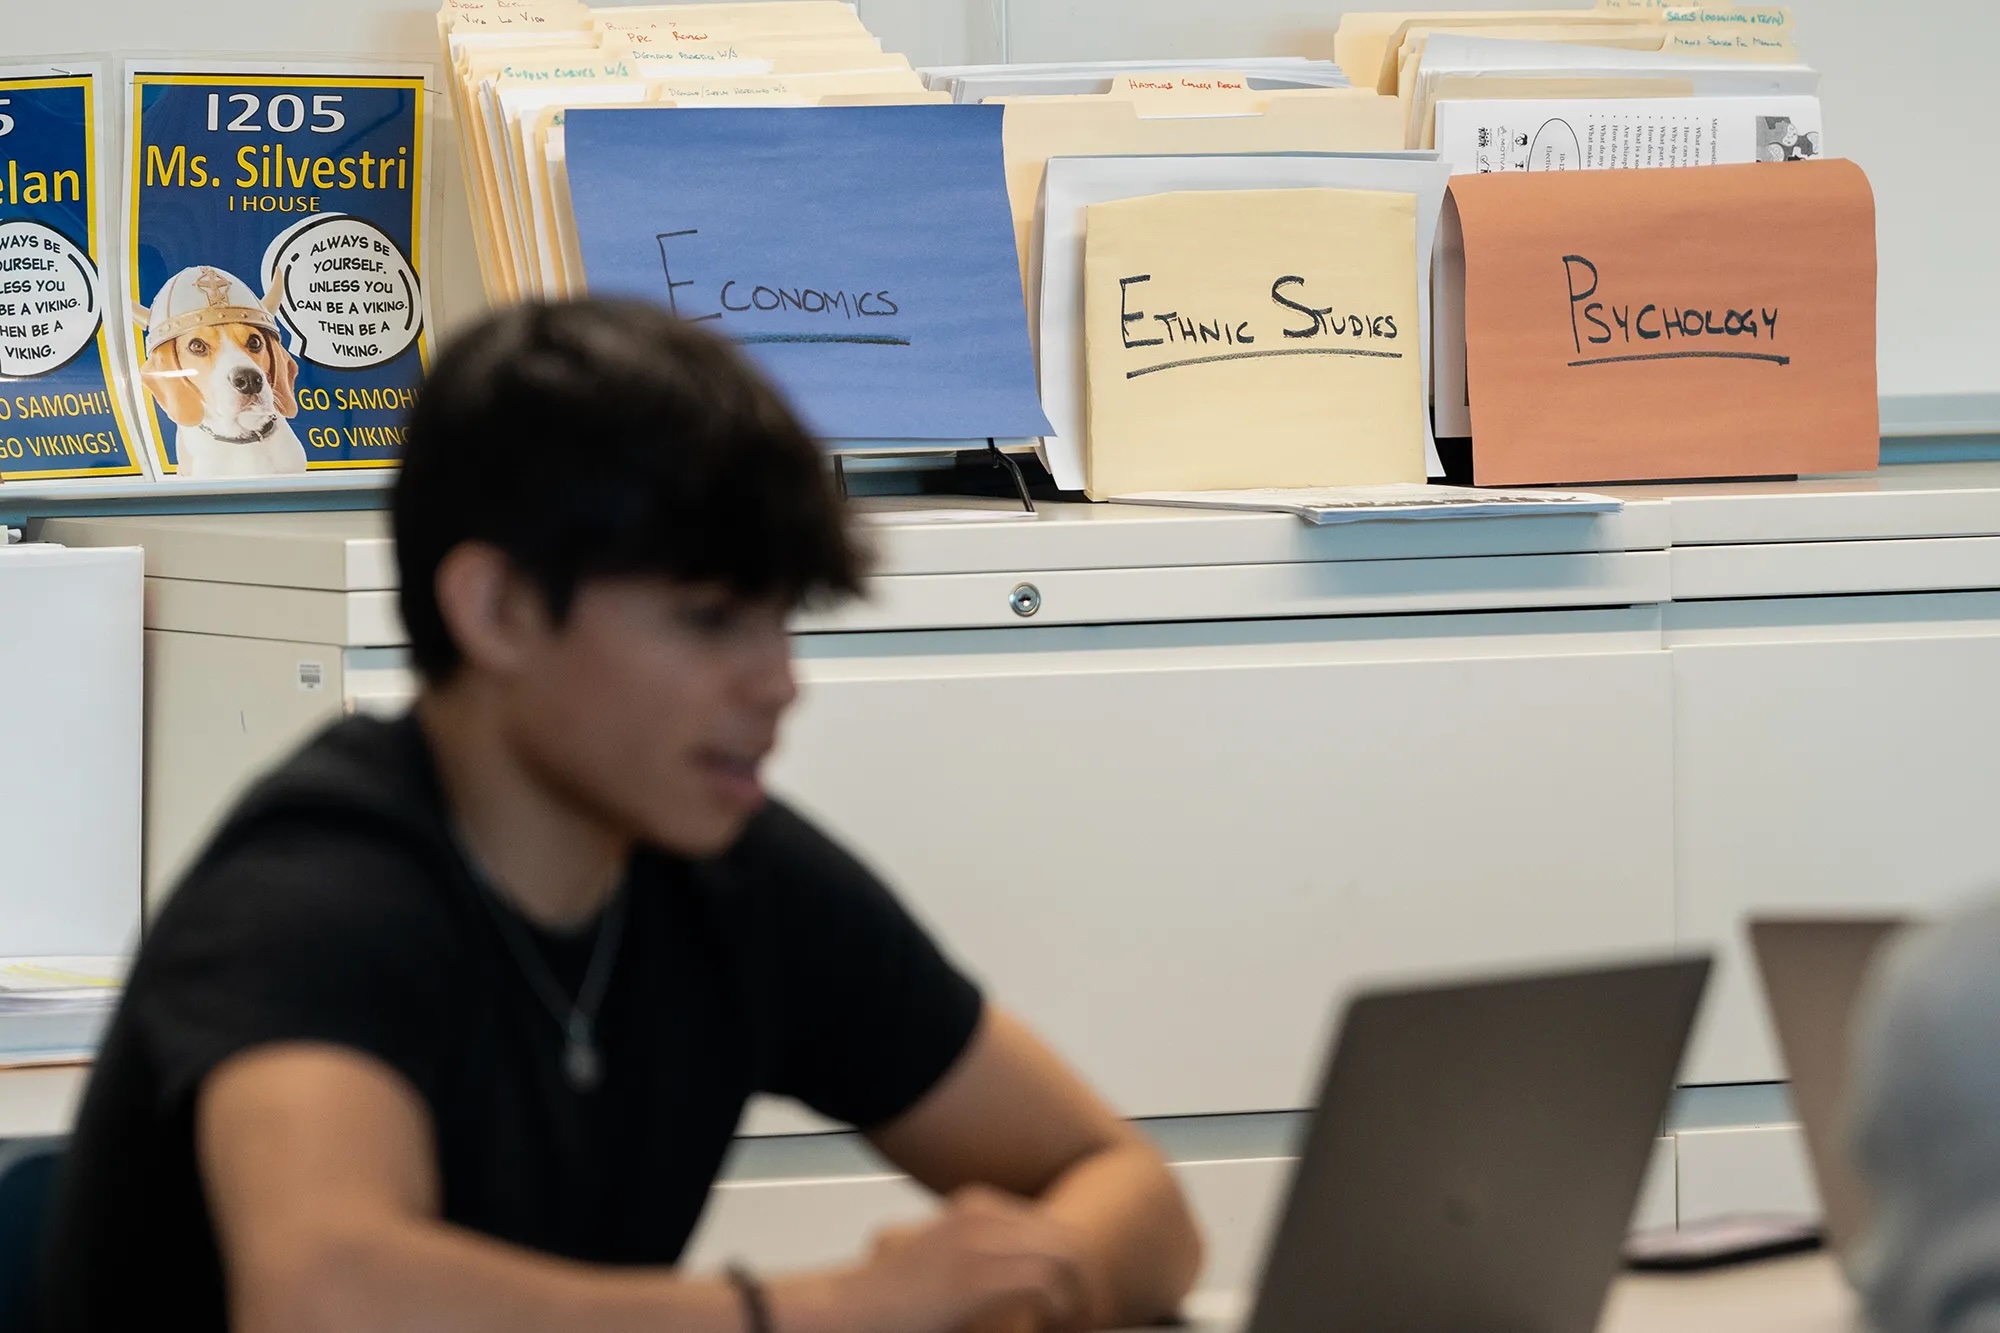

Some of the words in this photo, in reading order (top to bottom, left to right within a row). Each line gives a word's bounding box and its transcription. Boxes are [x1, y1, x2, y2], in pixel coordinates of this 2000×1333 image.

[1670, 126, 1678, 143] Why
[1599, 145, 1606, 154] do
[1612, 143, 1618, 153] do
[1647, 144, 1654, 154] do
[1671, 144, 1677, 154] do
[147, 145, 220, 188] Ms.
[236, 144, 407, 189] Silvestri
[1597, 156, 1604, 167] my
[1646, 155, 1652, 166] we
[0, 160, 80, 205] lan
[243, 195, 320, 213] HOUSE
[44, 239, 61, 254] BE
[310, 235, 369, 257] ALWAYS
[373, 240, 390, 257] BE
[0, 257, 58, 273] URSELF.
[313, 257, 387, 274] YOURSELF.
[656, 229, 898, 323] ECONOMICS
[36, 279, 65, 293] YOU
[309, 280, 360, 293] UNLESS
[364, 280, 393, 294] YOU
[21, 302, 31, 316] A
[35, 298, 81, 314] VIKING.
[297, 300, 322, 311] CAN
[326, 302, 344, 314] BE
[349, 302, 359, 315] A
[363, 300, 408, 314] VIKING.
[1119, 274, 1254, 348] ETHNIC
[1271, 275, 1398, 338] STUDIES
[1562, 255, 1778, 354] PSYCHOLOGY
[0, 324, 27, 338] HEN
[31, 323, 50, 337] BE
[54, 320, 63, 333] A
[318, 320, 355, 336] THEN
[359, 323, 376, 336] BE
[381, 320, 391, 332] A
[5, 345, 55, 359] VIKING.
[332, 342, 383, 357] VIKING.
[15, 390, 110, 420] SAMOHI!
[298, 388, 331, 411] GO
[25, 431, 119, 457] VIKINGS!
[308, 427, 341, 448] GO
